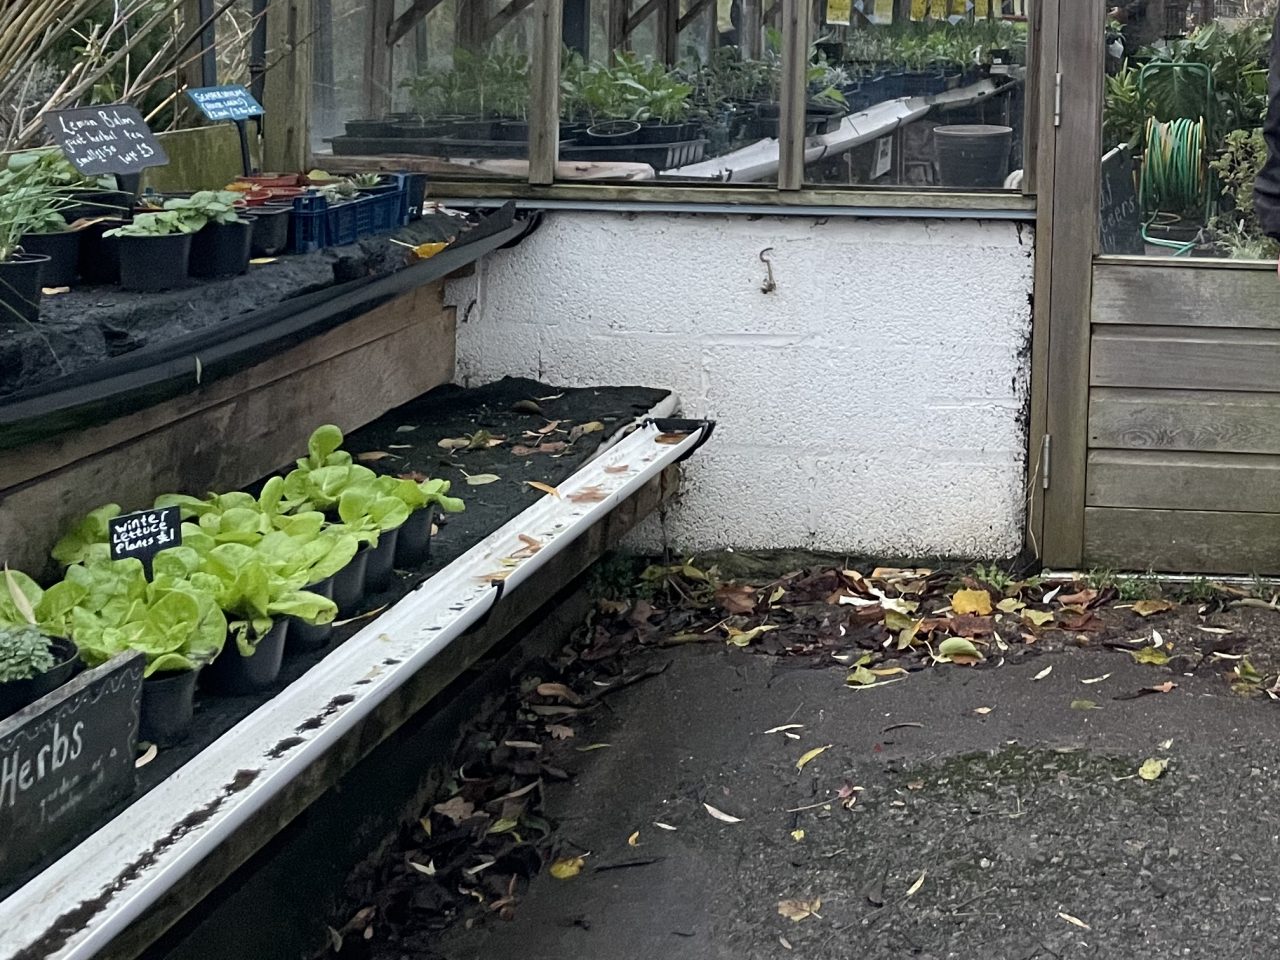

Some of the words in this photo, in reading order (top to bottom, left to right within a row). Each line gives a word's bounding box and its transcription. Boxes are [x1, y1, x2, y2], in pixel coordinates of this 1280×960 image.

[59, 115, 98, 135] Lemon
[98, 110, 136, 128] Balm
[85, 129, 118, 142] herbal
[123, 129, 145, 140] tea
[136, 142, 155, 158] £3
[113, 521, 168, 544] Lettuce
[0, 721, 84, 809] Herbs
